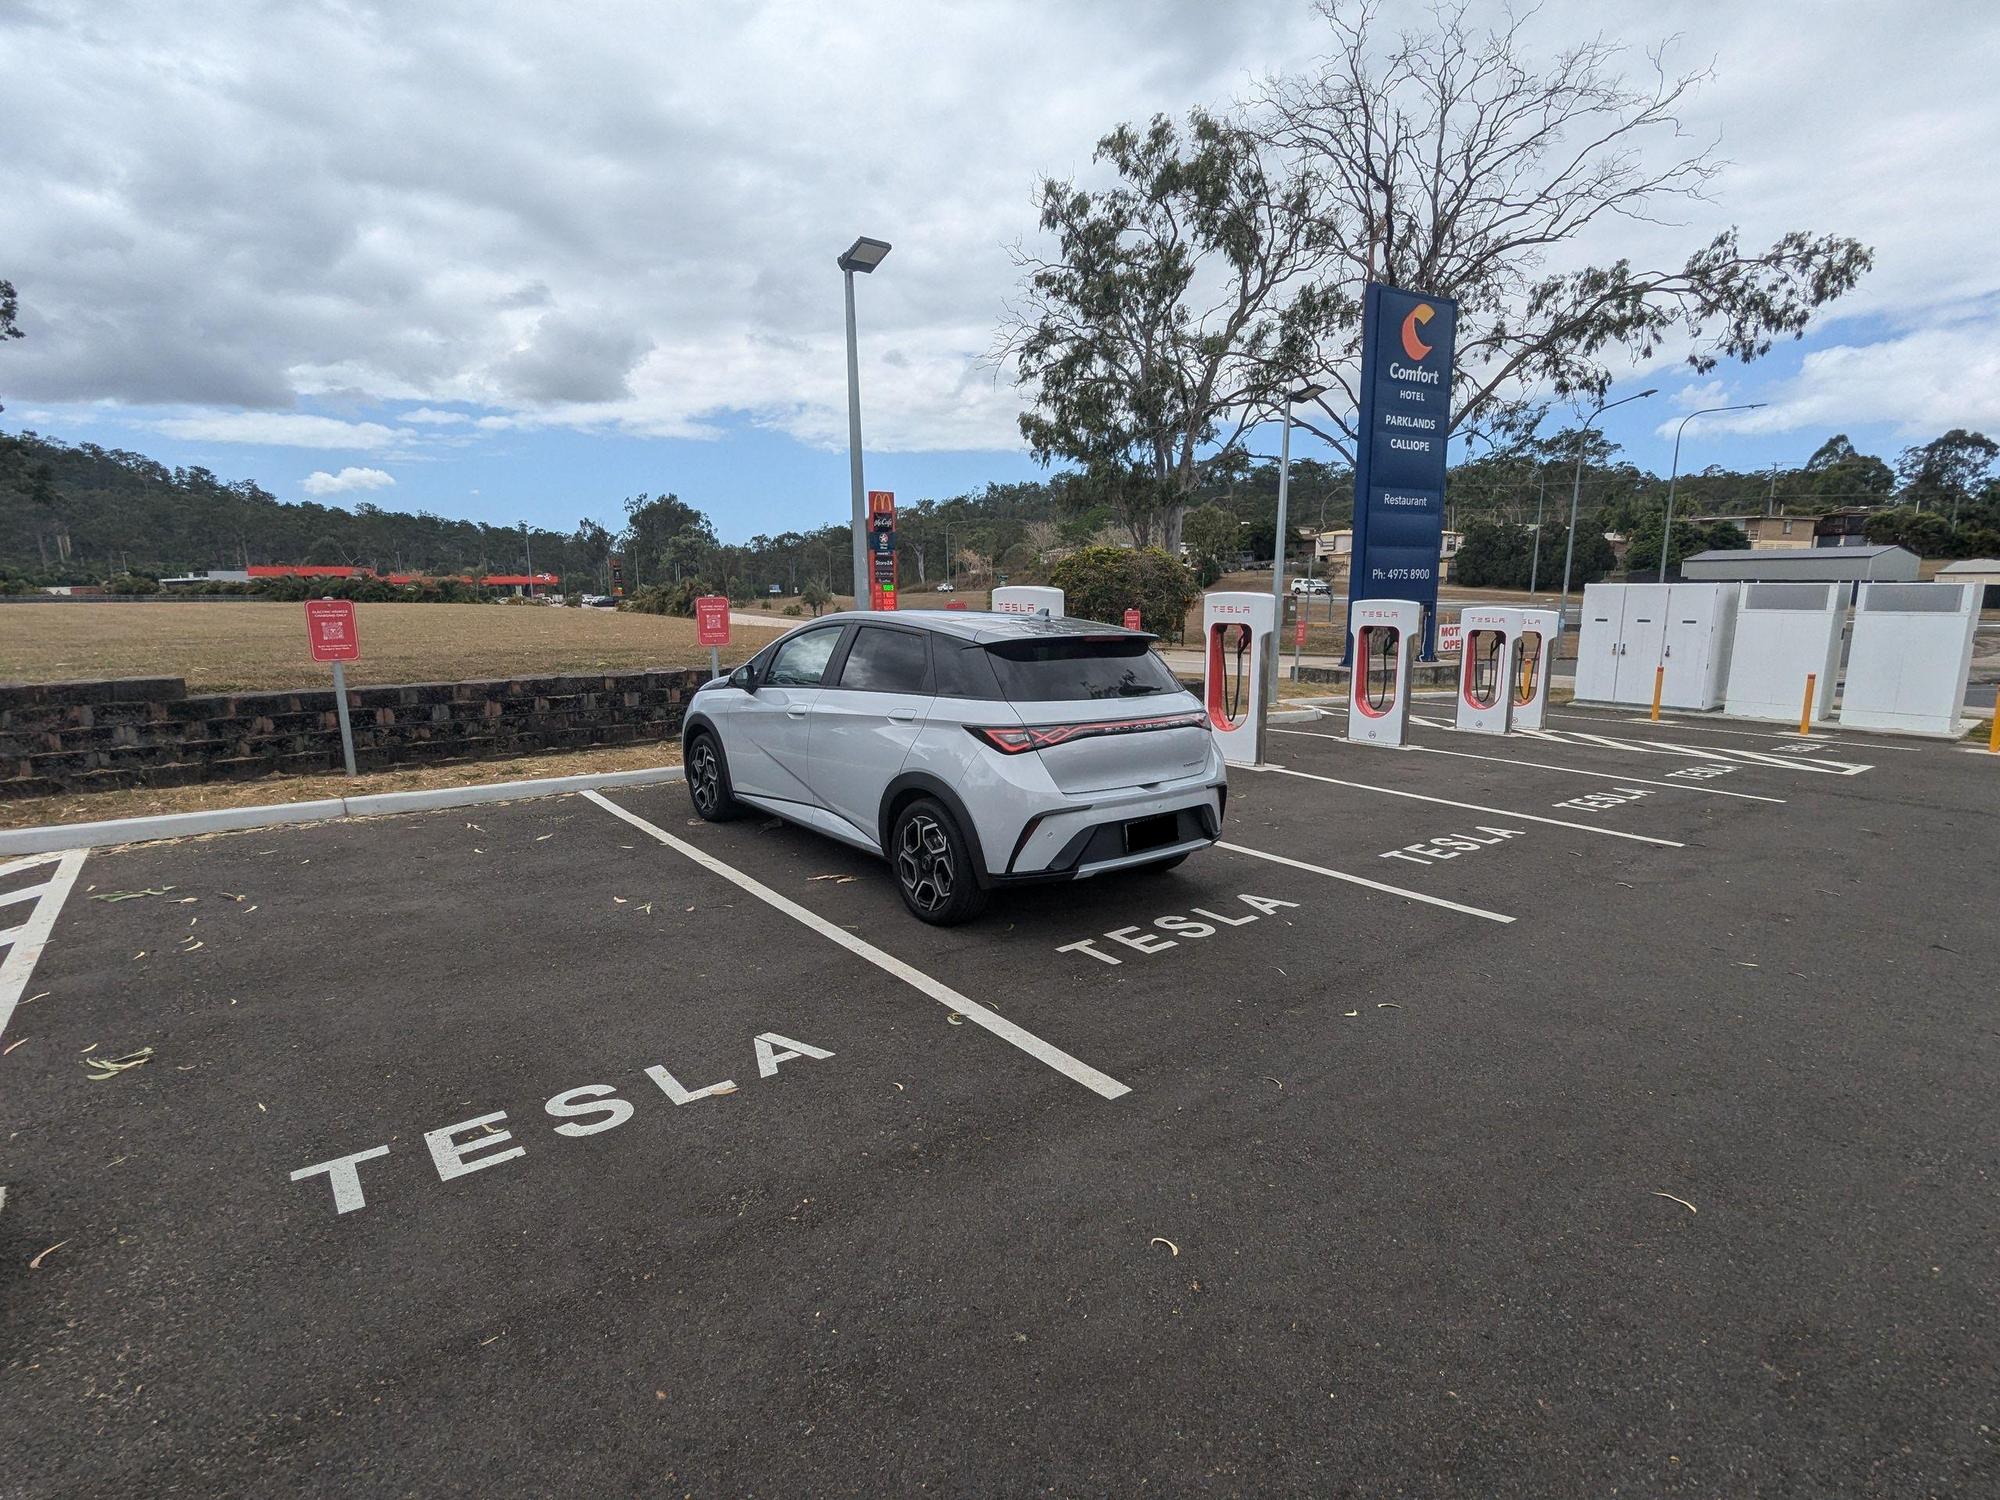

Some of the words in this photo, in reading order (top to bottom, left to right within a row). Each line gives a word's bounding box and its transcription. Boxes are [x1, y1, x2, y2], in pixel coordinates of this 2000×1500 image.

[1389, 362, 1440, 385] Comfort
[1400, 390, 1425, 402] HOTEL
[1385, 414, 1436, 430] PARKLANDS
[1390, 438, 1430, 452] CALLIOPE
[1383, 493, 1428, 507] Restaurant
[1372, 568, 1386, 580] Ph:
[1387, 568, 1409, 580] 4975
[1410, 568, 1430, 580] 8900
[998, 602, 1035, 613] TESLA
[1212, 605, 1250, 614] TESLA
[1361, 610, 1399, 618] TESLA
[1471, 616, 1506, 624] TESLA
[1440, 626, 1461, 638] MOT
[1443, 639, 1461, 650] OPE
[1551, 787, 1656, 812] TESLA
[1378, 825, 1526, 865] TESLA
[1055, 893, 1301, 965] TESLA
[290, 1032, 836, 1215] TESLA
